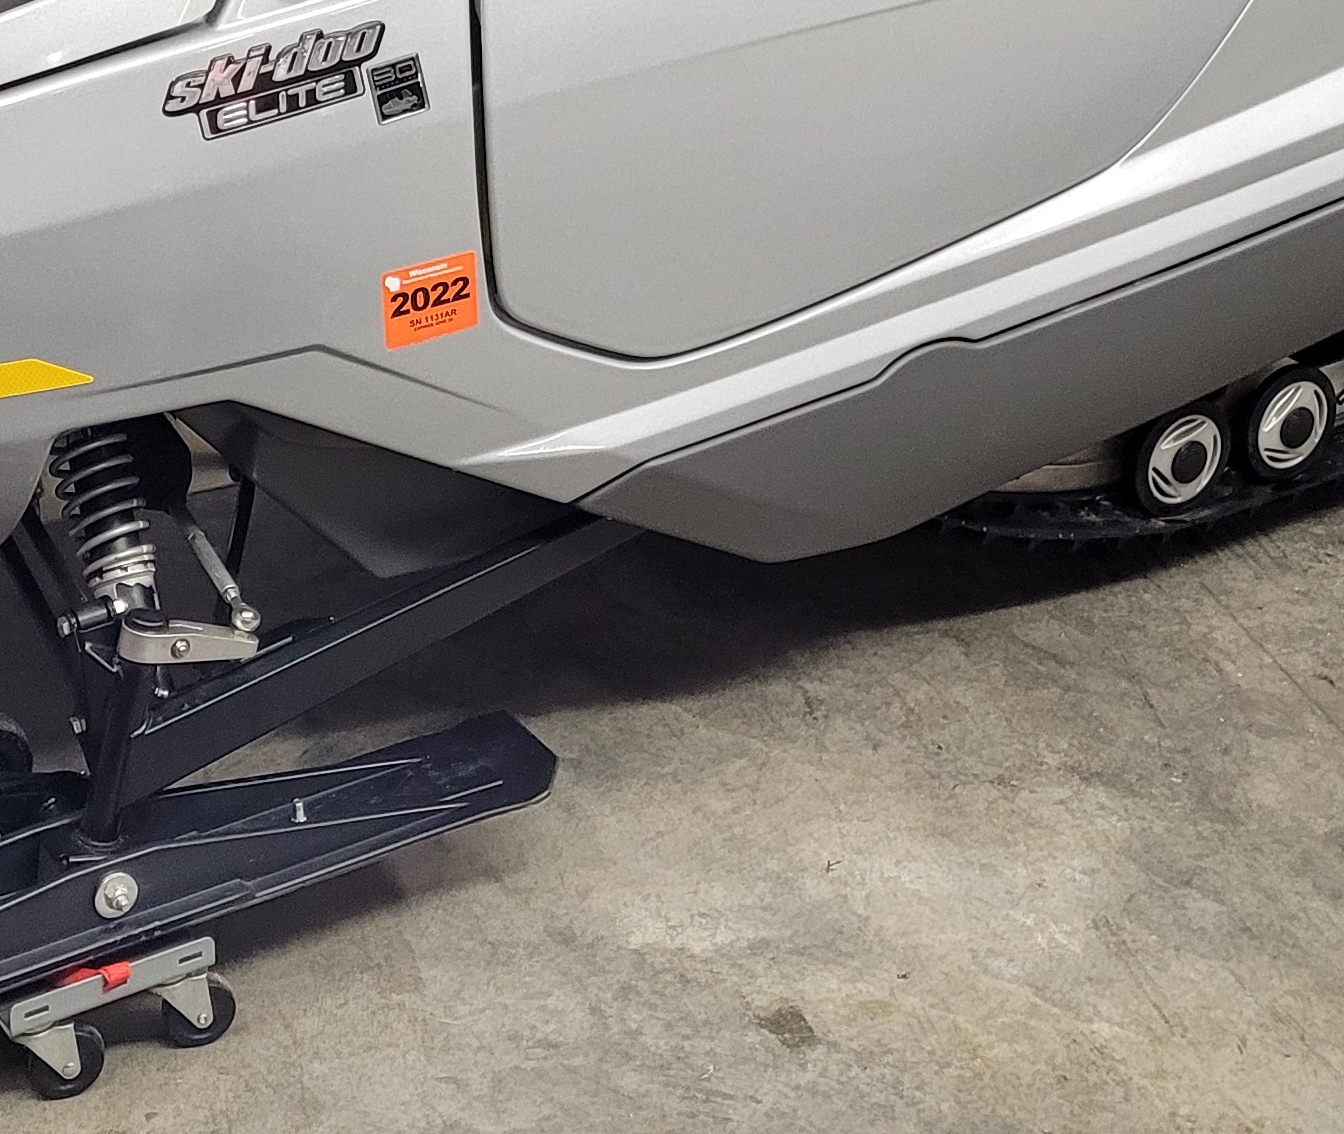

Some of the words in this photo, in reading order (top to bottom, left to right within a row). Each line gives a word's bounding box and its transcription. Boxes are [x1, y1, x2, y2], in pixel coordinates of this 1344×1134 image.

[162, 21, 385, 115] ski-doo
[373, 60, 416, 86] 30
[216, 73, 347, 131] ELITE
[390, 276, 471, 319] 2022
[409, 317, 422, 328] SN
